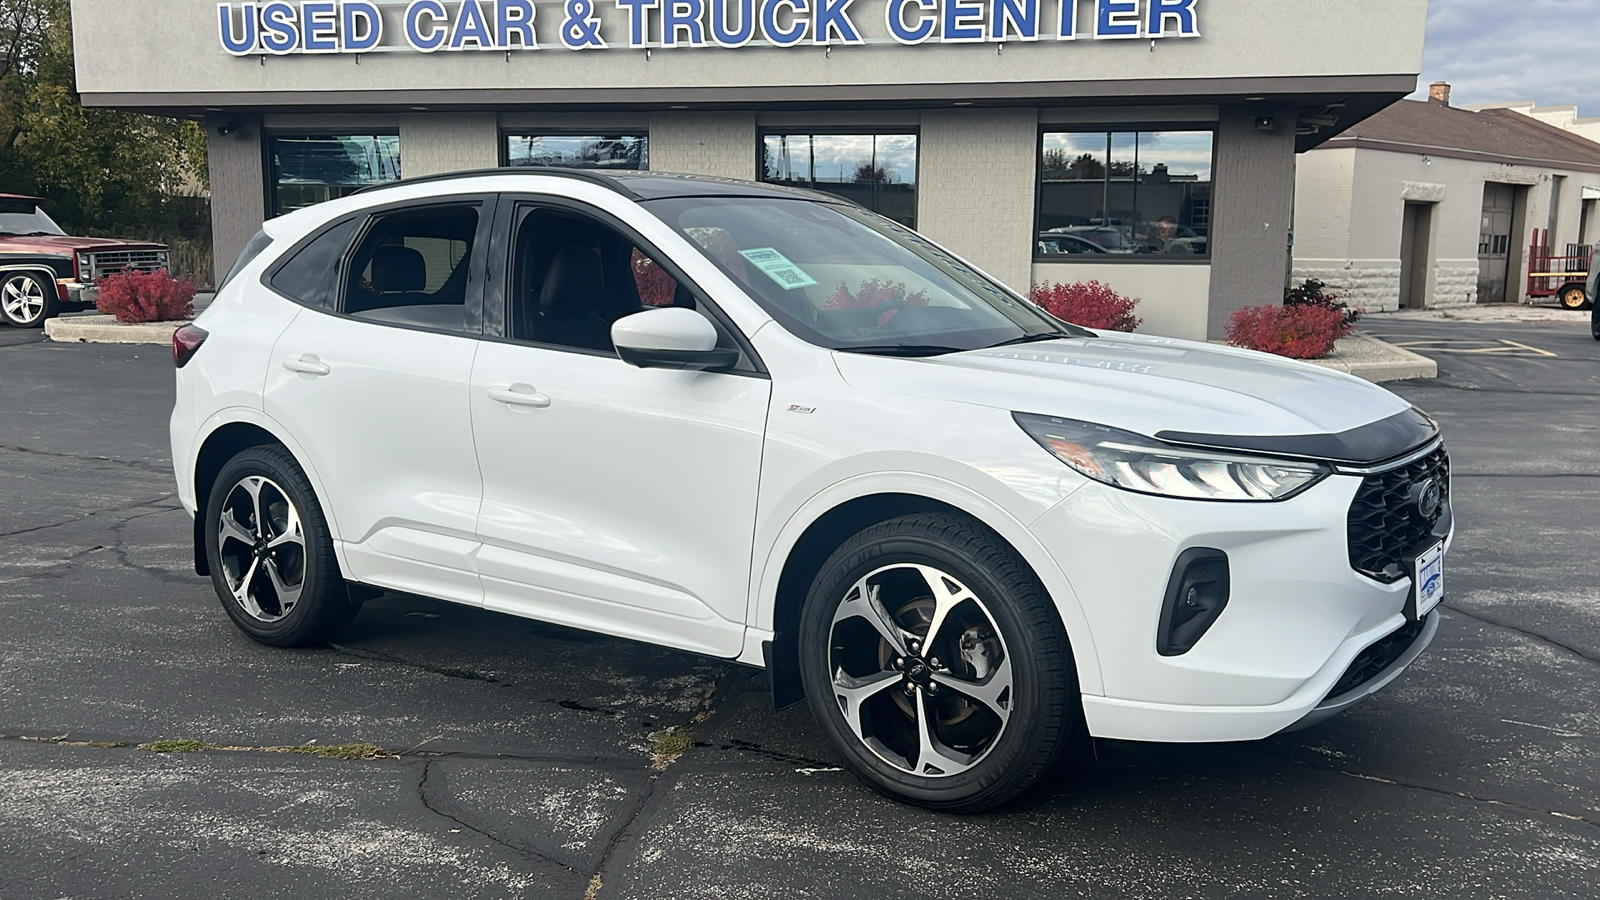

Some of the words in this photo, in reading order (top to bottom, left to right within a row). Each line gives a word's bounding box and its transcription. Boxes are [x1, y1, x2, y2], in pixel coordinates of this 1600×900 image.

[217, 0, 384, 56] USED
[403, 0, 540, 53] CAR
[559, 0, 609, 50] &
[616, 0, 866, 49] TRUCK
[885, 0, 1201, 45] CENTER
